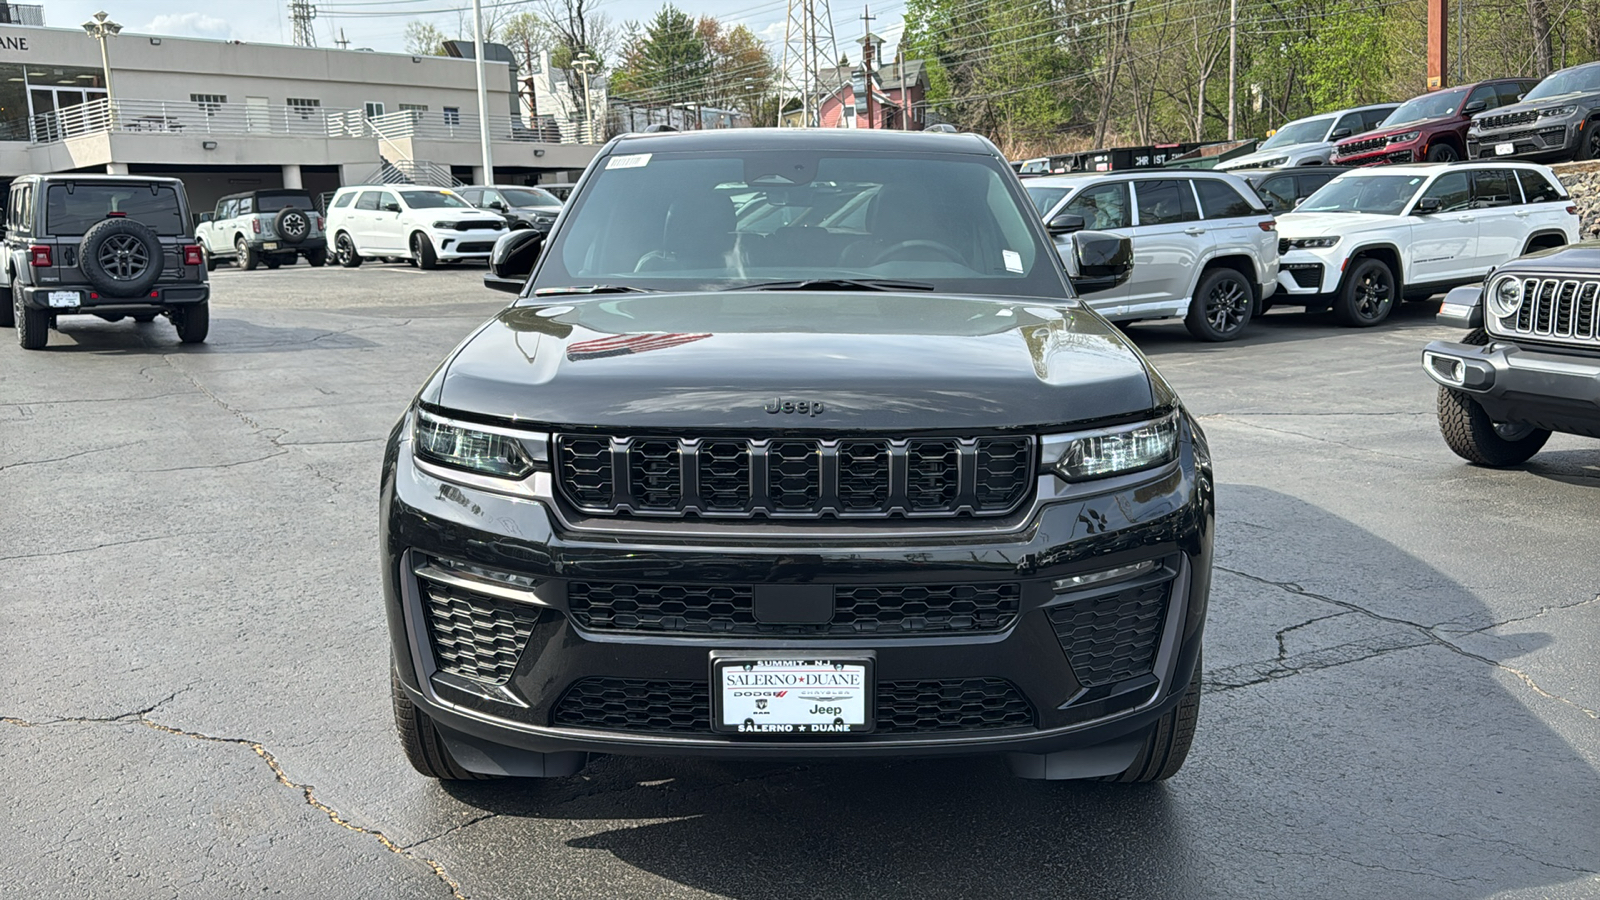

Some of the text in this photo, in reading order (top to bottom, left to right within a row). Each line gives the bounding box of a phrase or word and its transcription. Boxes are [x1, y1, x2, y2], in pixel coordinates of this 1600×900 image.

[763, 397, 824, 418] Jeep
[726, 674, 860, 686] SALERNO DUANE
[809, 704, 842, 716] Jeep
[737, 724, 851, 732] SALERNO DUANE
